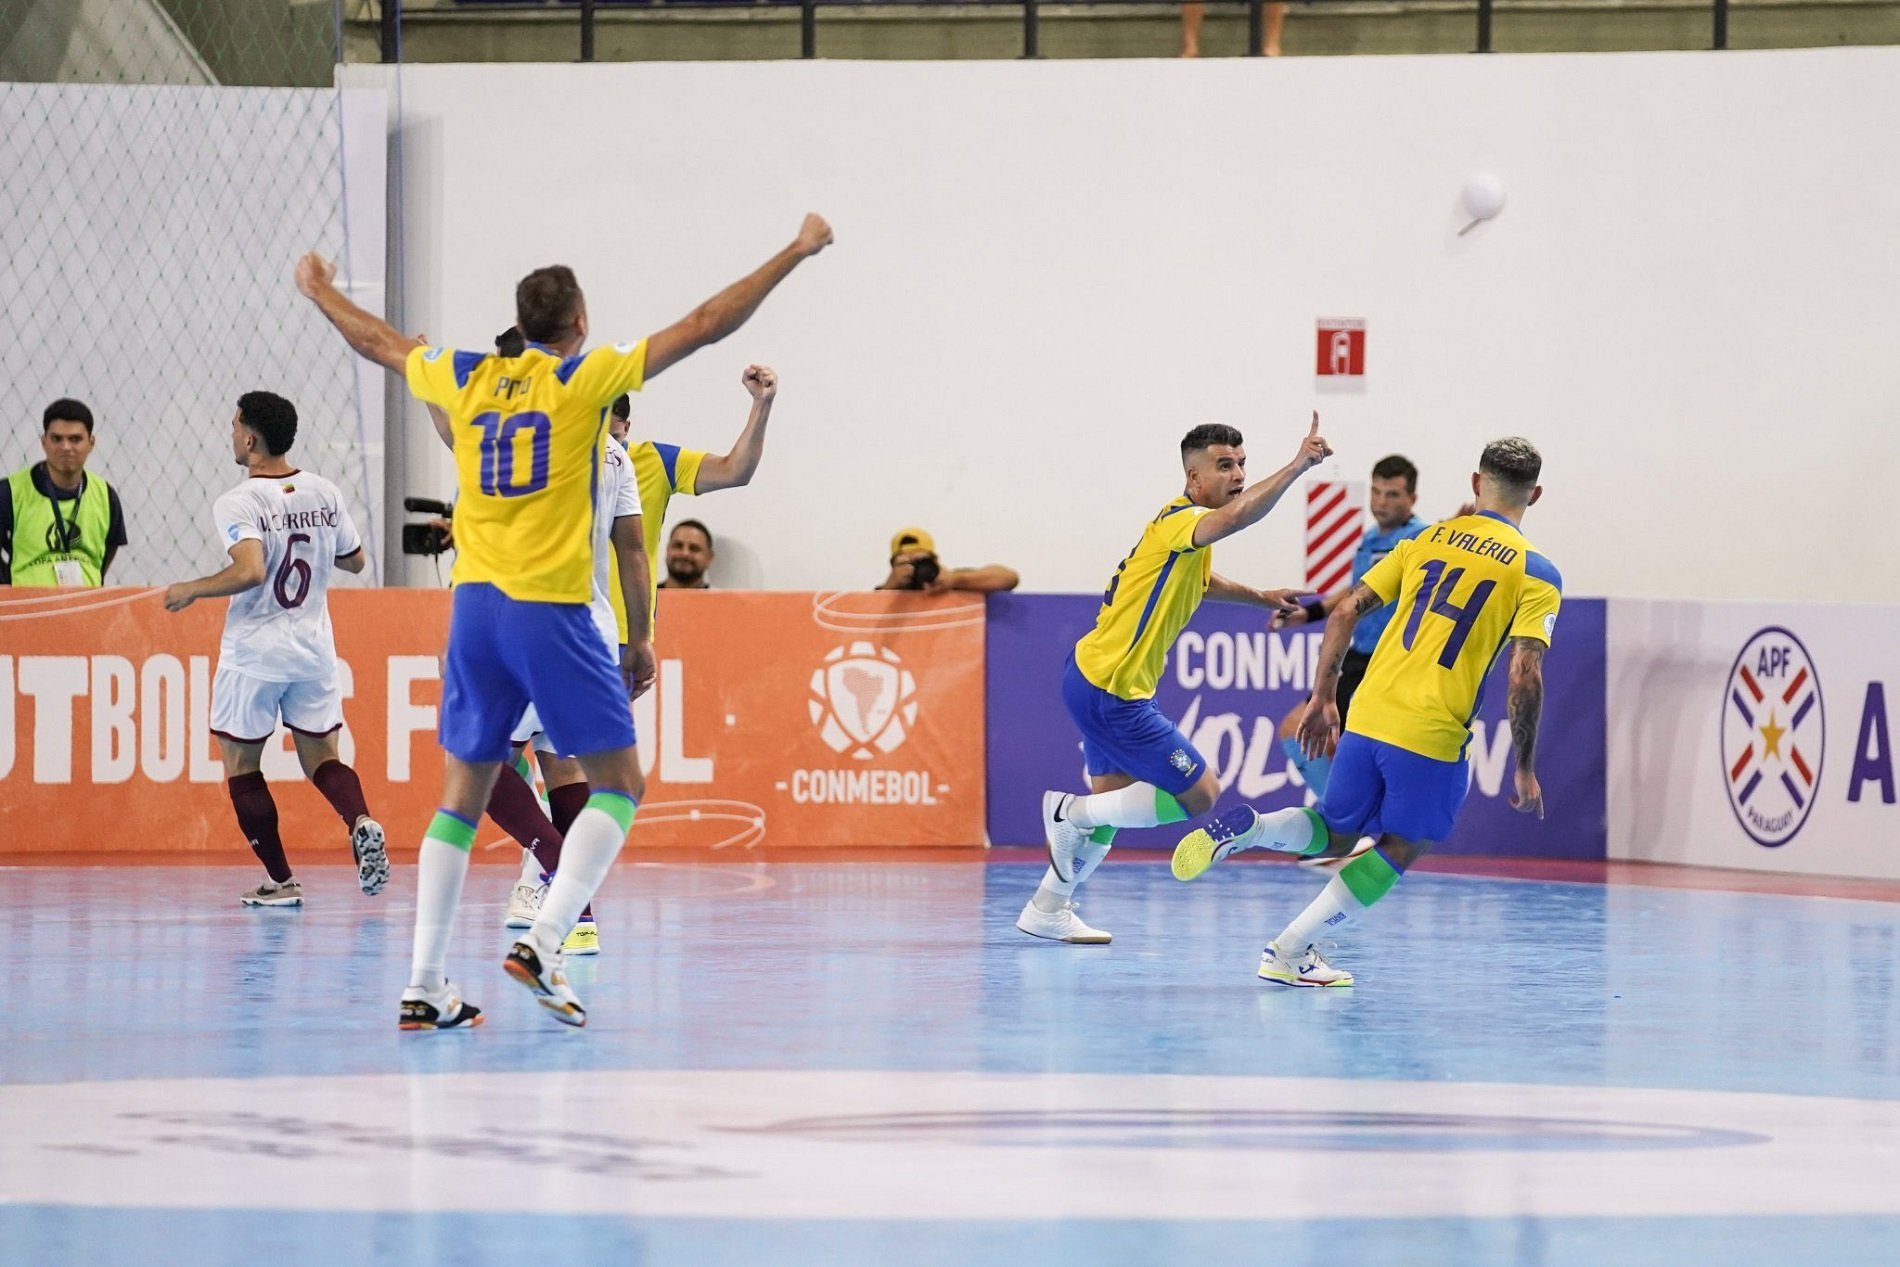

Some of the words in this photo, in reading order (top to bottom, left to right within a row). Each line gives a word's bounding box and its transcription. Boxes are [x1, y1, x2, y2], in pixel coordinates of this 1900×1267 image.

[470, 410, 552, 498] 10
[273, 533, 312, 609] 6
[1430, 526, 1446, 543] F.
[1447, 530, 1519, 567] VALÉRIO
[1419, 559, 1497, 671] 14
[1757, 645, 1792, 678] APF
[1747, 805, 1794, 834] PARAGUAY
